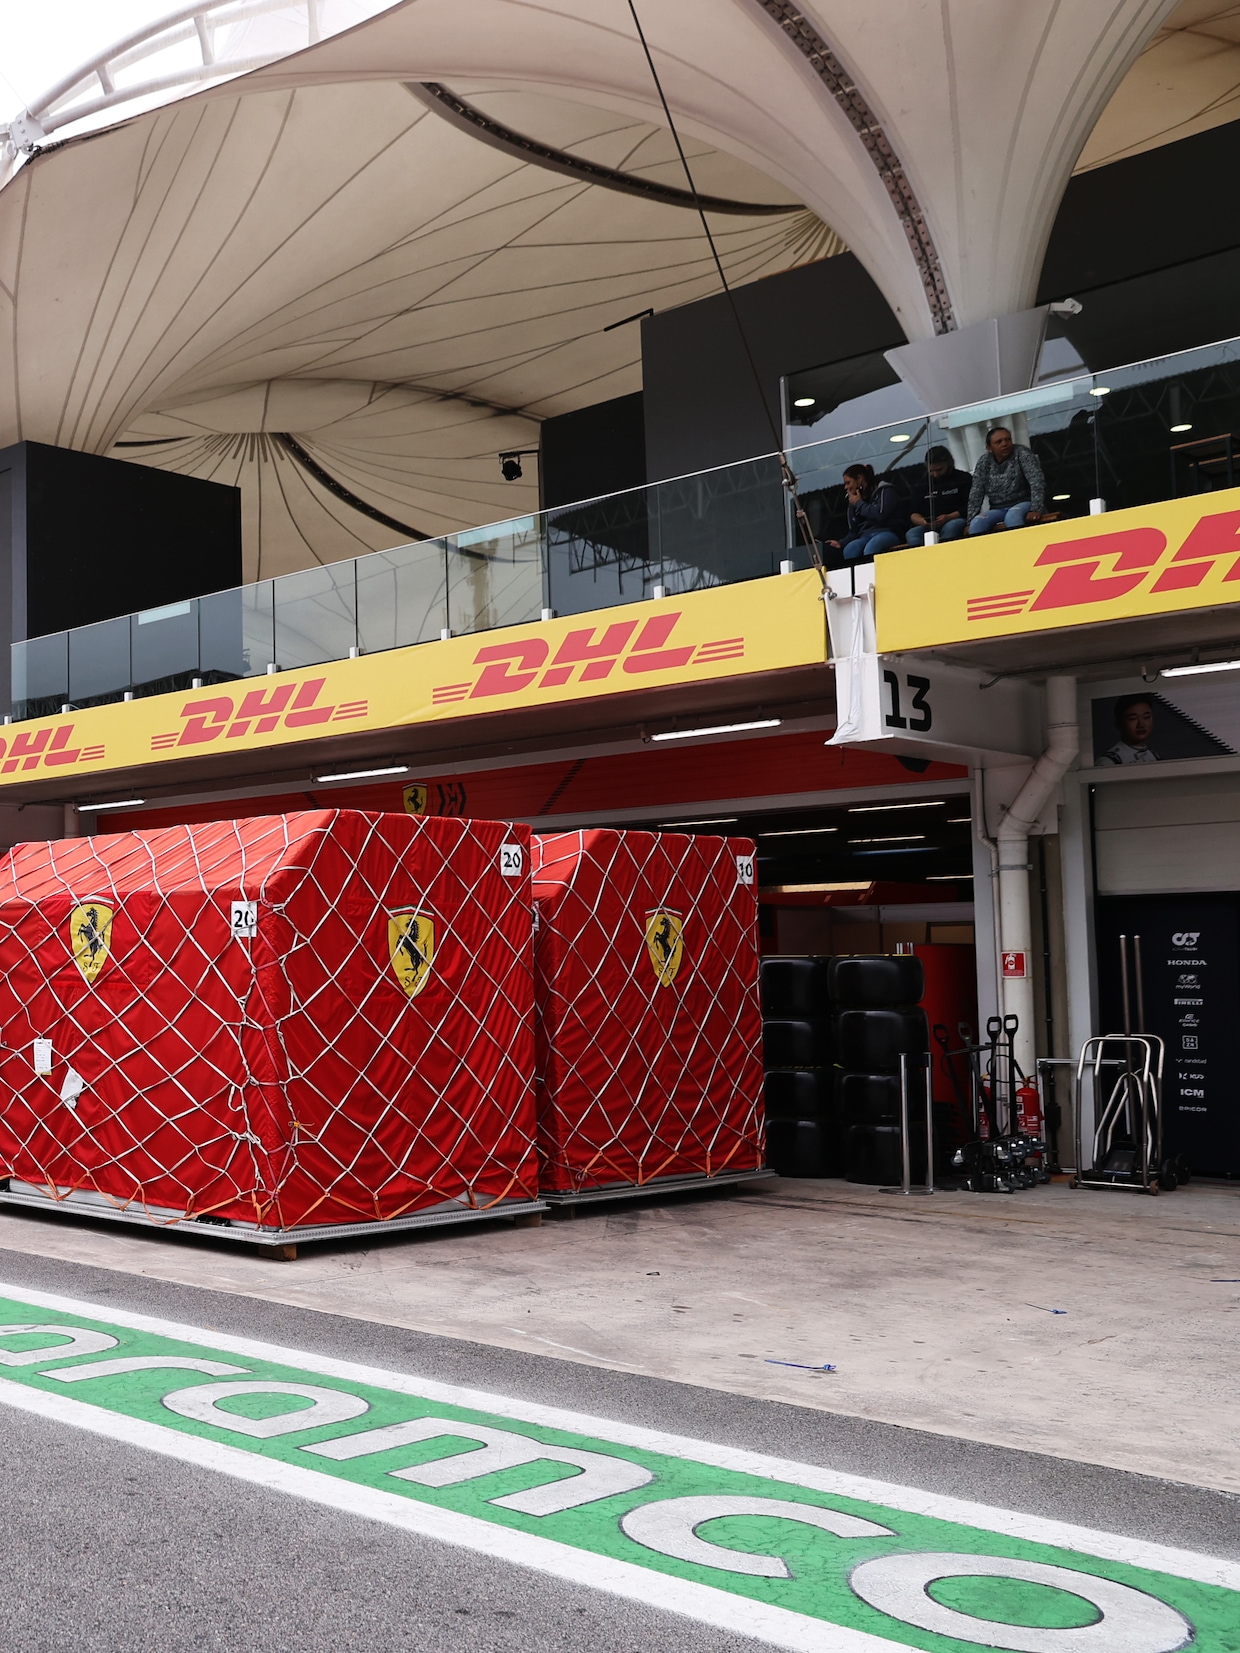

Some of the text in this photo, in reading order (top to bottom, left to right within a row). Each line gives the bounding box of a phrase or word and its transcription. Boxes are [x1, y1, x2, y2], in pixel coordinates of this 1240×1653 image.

[469, 613, 697, 699] DHL
[178, 678, 335, 748] DHL
[884, 670, 932, 732] 13
[504, 851, 520, 868] 20
[739, 863, 753, 877] 10
